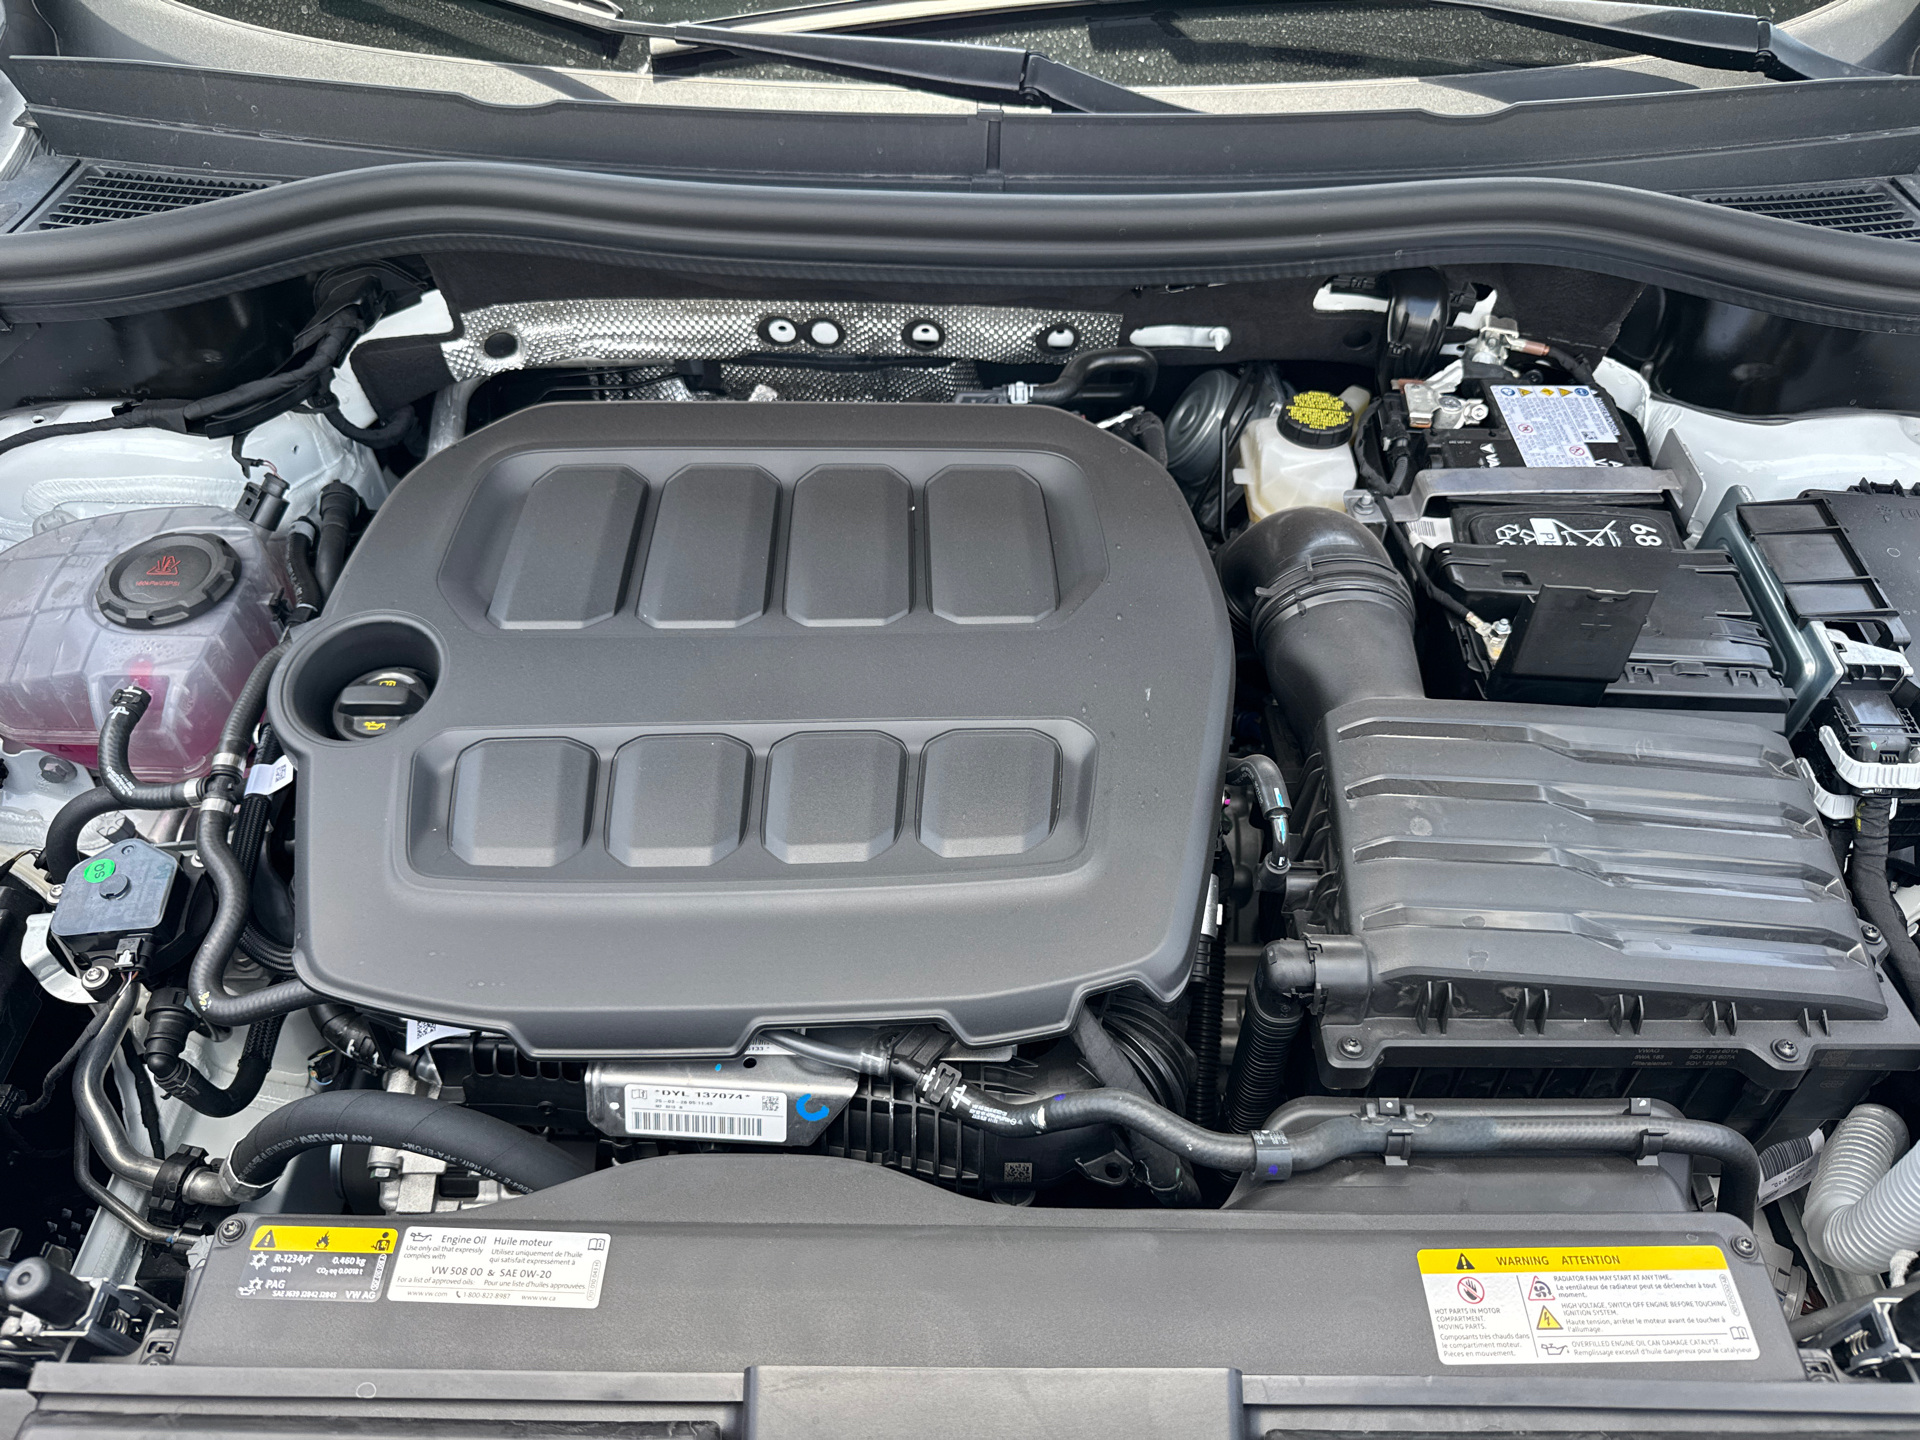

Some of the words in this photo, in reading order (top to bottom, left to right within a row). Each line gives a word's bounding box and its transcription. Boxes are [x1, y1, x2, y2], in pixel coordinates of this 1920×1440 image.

[1630, 523, 1662, 547] 68
[441, 1235, 472, 1245] Engine
[473, 1236, 487, 1244] Oil
[494, 1237, 517, 1246] Huile
[519, 1238, 552, 1247] moteur
[274, 1254, 314, 1266] R-1234yf
[332, 1256, 355, 1264] 0.460
[356, 1257, 366, 1268] kg
[1496, 1256, 1549, 1265] WARNING
[1562, 1255, 1620, 1265] ATTENTION
[329, 1268, 338, 1276] eq
[431, 1266, 448, 1275] VW
[450, 1267, 468, 1275] 508
[470, 1268, 483, 1276] 00
[500, 1269, 518, 1277] SAE
[520, 1270, 552, 1279] 0W-20
[265, 1280, 286, 1289] PAG
[345, 1290, 361, 1298] VW
